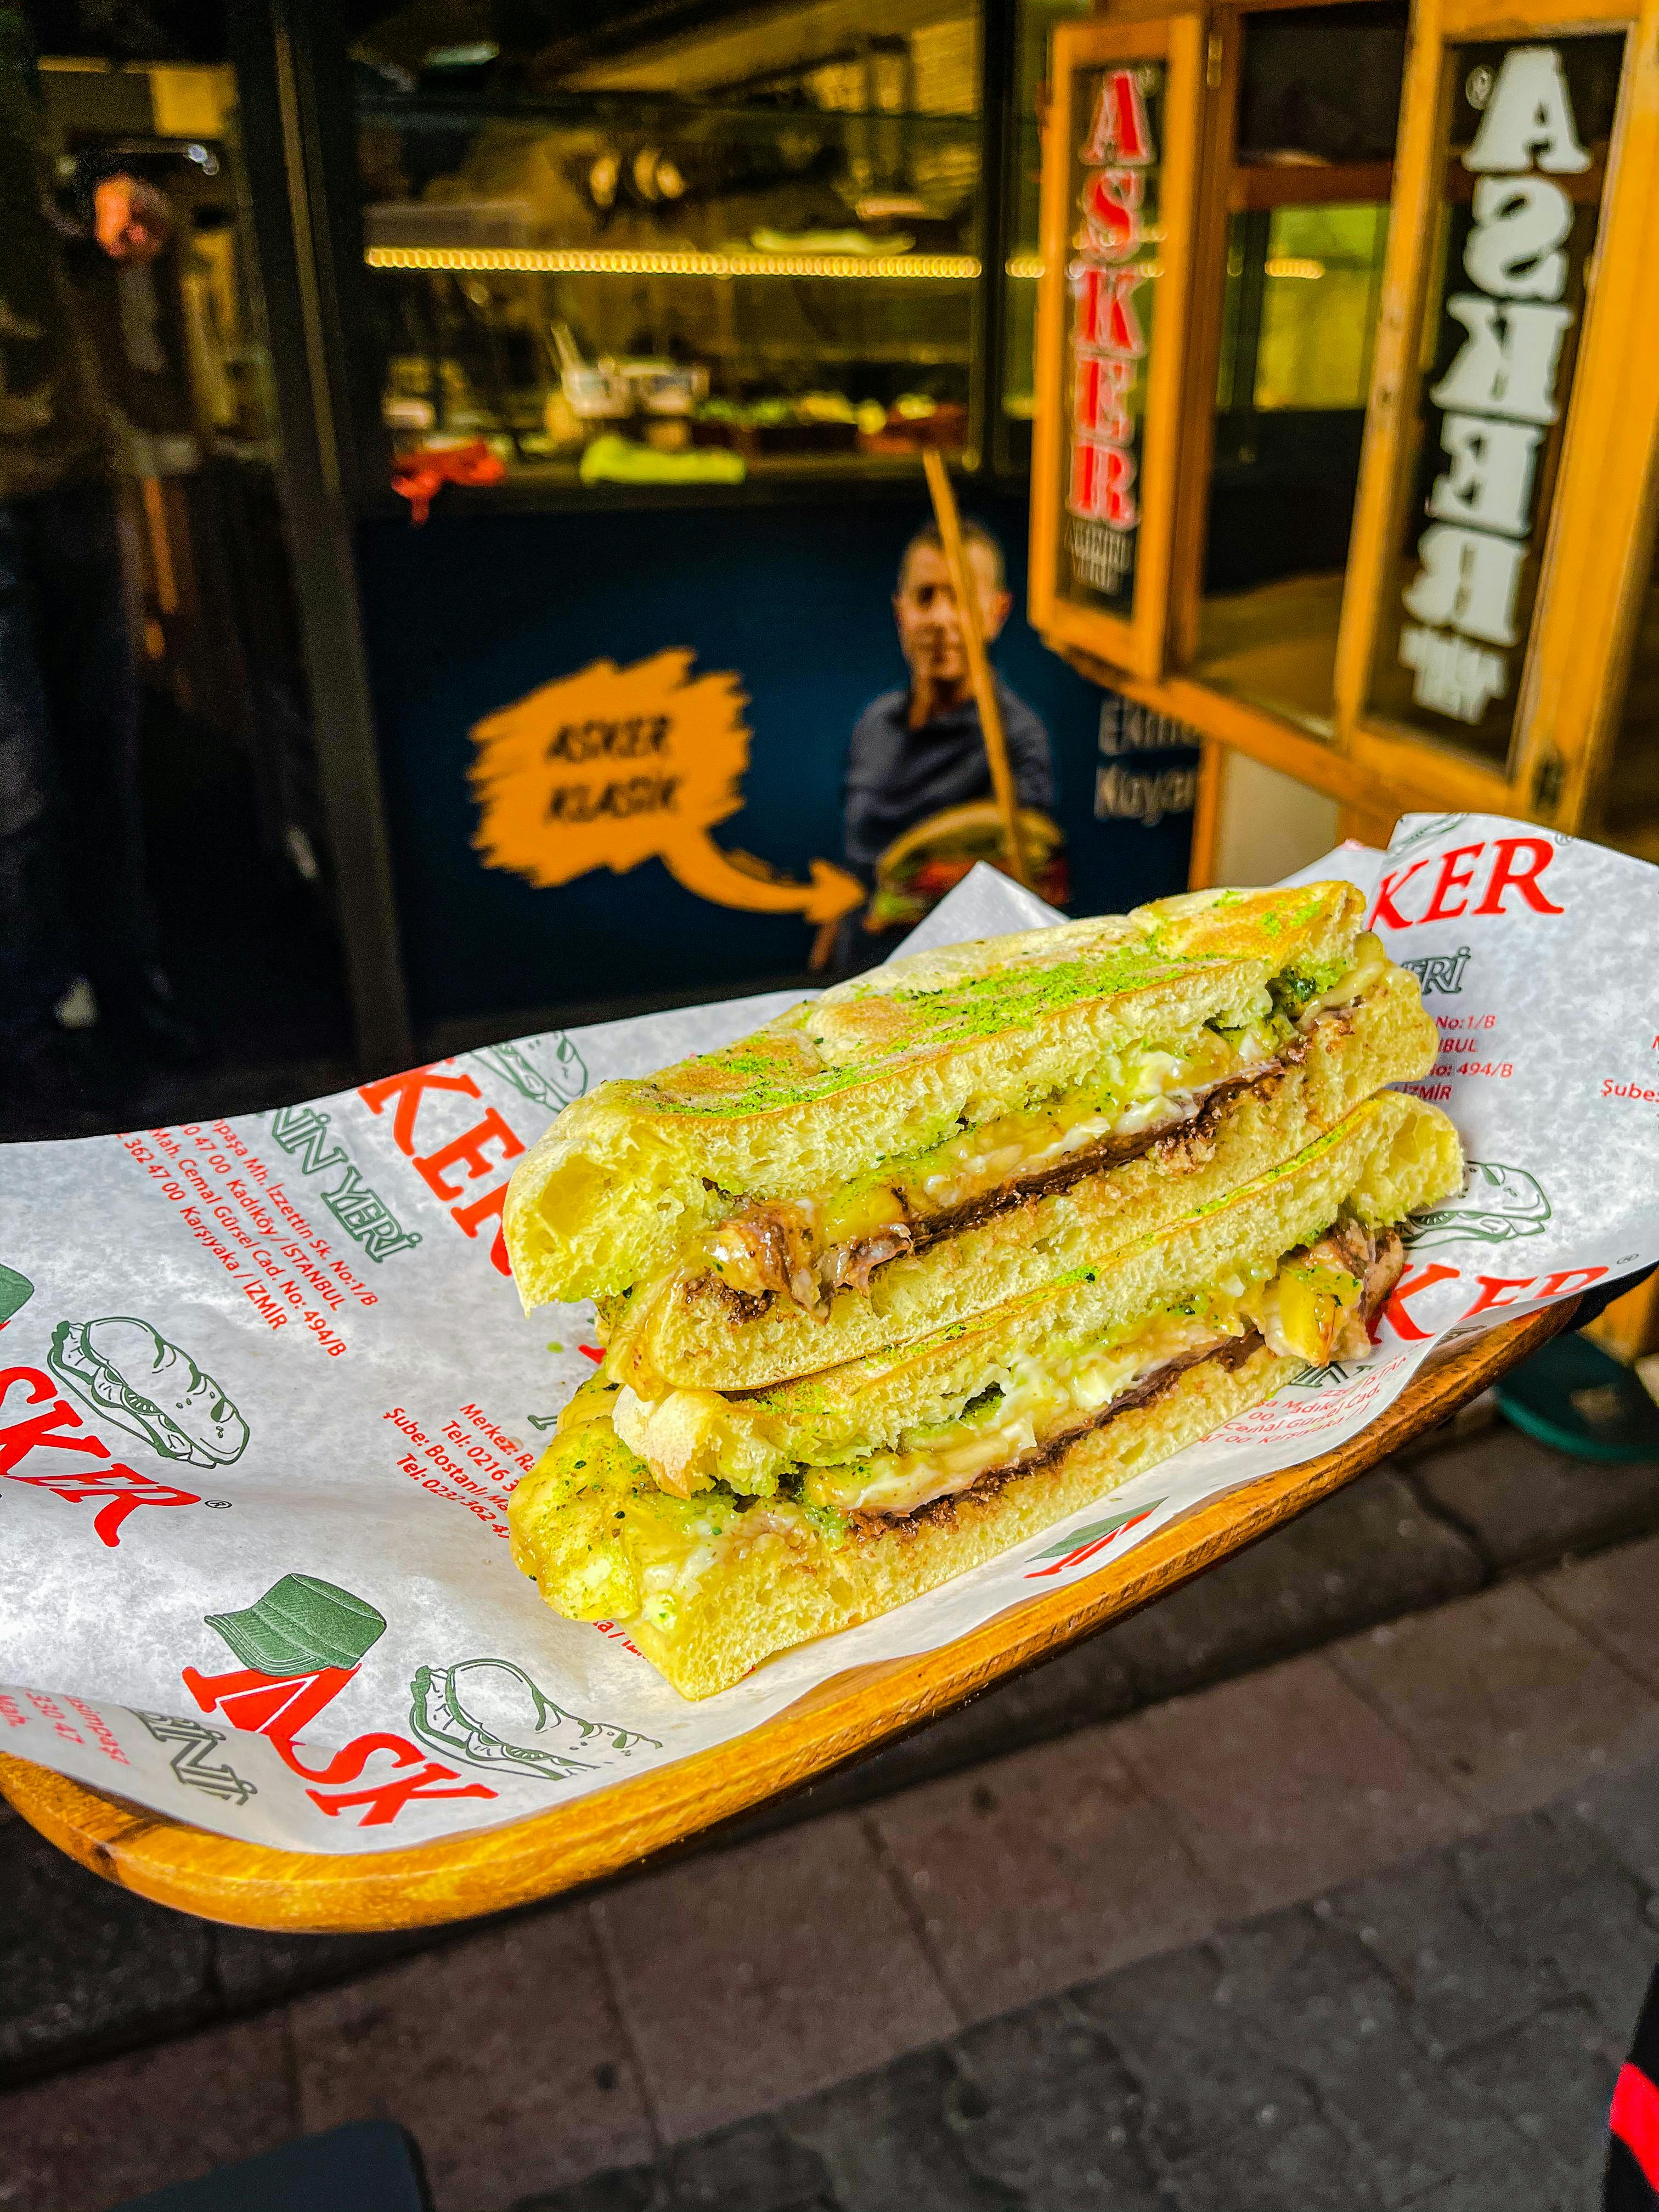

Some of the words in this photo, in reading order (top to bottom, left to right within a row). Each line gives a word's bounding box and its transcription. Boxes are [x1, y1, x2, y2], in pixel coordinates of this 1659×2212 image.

[1066, 68, 1156, 528] ASKER
[1366, 838, 1565, 930] KER
[1457, 1062, 1513, 1078] 494/B
[123, 1138, 154, 1164] 362
[148, 1165, 171, 1178] 47
[161, 1182, 185, 1201] 00
[180, 1206, 239, 1271] Karşıyaka
[195, 1137, 217, 1150] 47
[208, 1154, 232, 1173] 00
[225, 1179, 278, 1235] Kadıköy
[243, 1158, 268, 1186] Mh.
[309, 1239, 332, 1261] Sk.
[329, 1260, 378, 1306] No:1/B
[320, 1166, 422, 1262] YERİ
[178, 1159, 223, 1204] Cemal
[213, 1206, 261, 1248] Gürsel
[252, 1250, 286, 1281] Cad.
[279, 1280, 307, 1309] No:
[304, 1311, 347, 1357] 494/B
[383, 1408, 430, 1447] Şube:
[425, 1444, 487, 1496] Bostanlı
[442, 1420, 472, 1447] Tel:
[467, 1446, 510, 1481] 0216
[459, 1403, 518, 1456] Merkez:
[1248, 1412, 1274, 1421] 00
[397, 1453, 427, 1480] Tel:
[422, 1479, 466, 1501] 0232
[460, 1500, 496, 1521] 362
